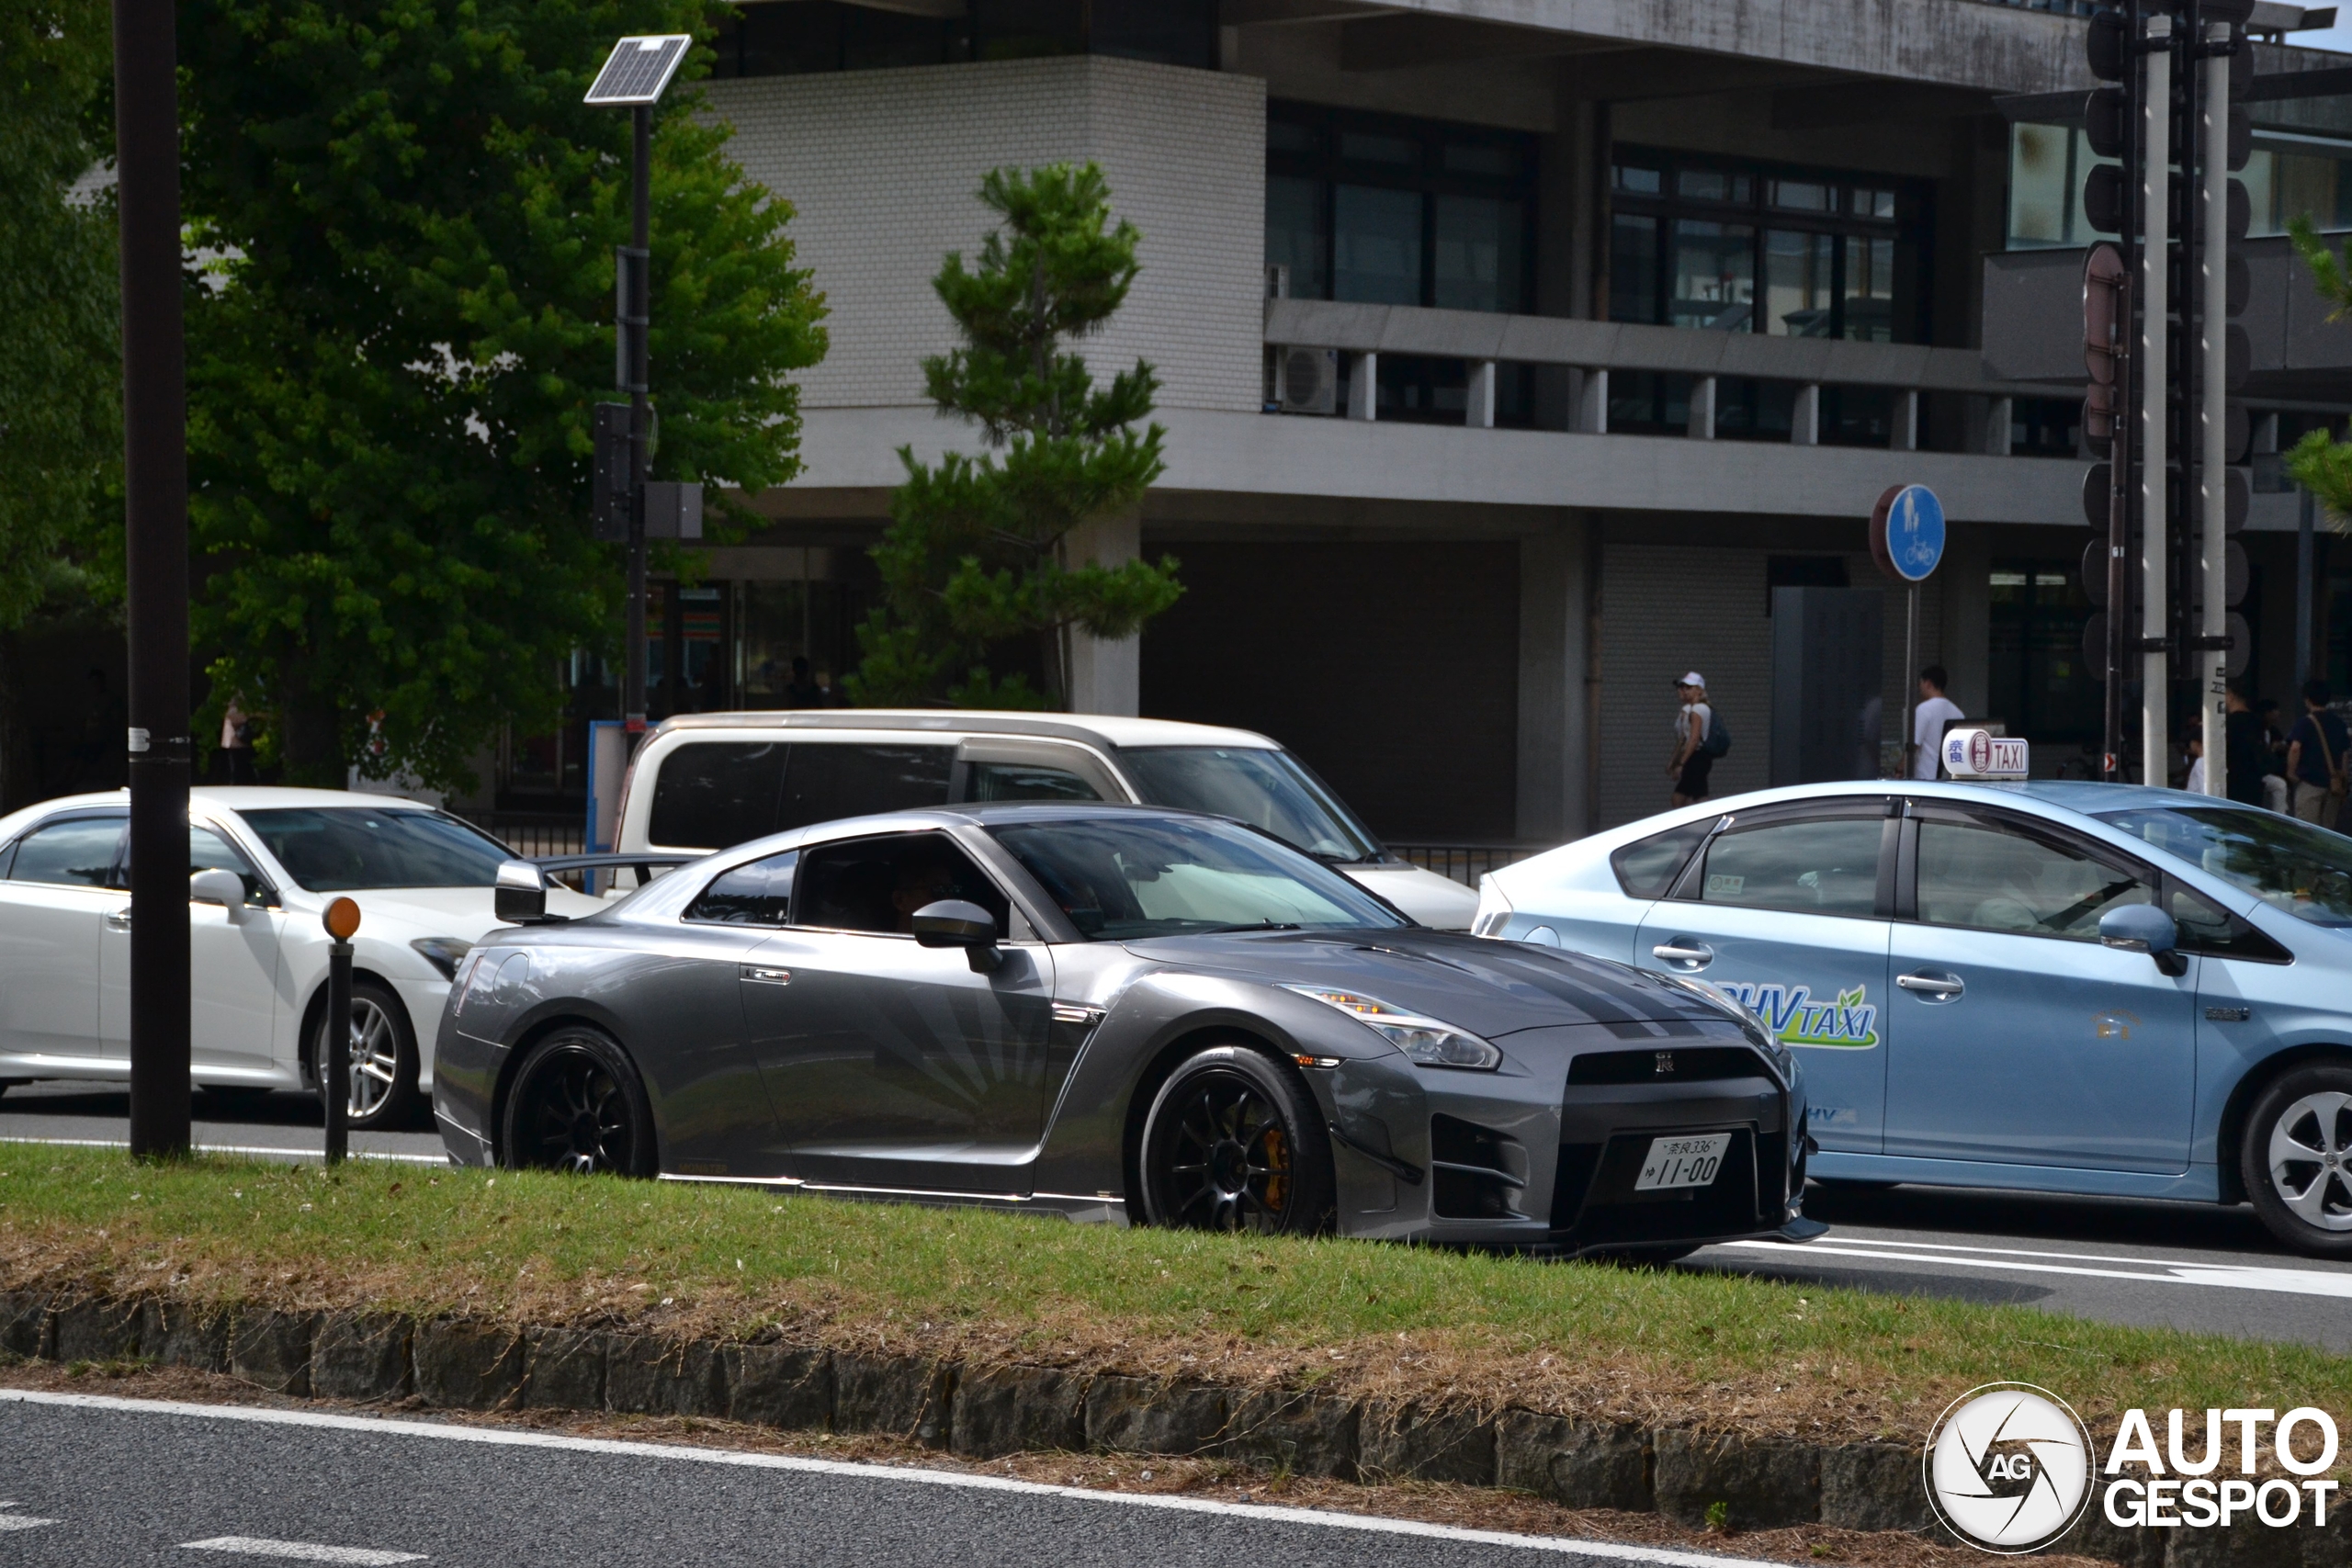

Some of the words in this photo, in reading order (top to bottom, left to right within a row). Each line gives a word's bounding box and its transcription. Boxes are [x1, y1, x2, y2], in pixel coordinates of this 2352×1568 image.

[1948, 739, 1964, 763] 奈良
[1995, 745, 2023, 769] TAXI
[1801, 1006, 1871, 1036] TAXI
[1645, 1166, 1656, 1179] ゆ
[1657, 1156, 1718, 1185] 11-00
